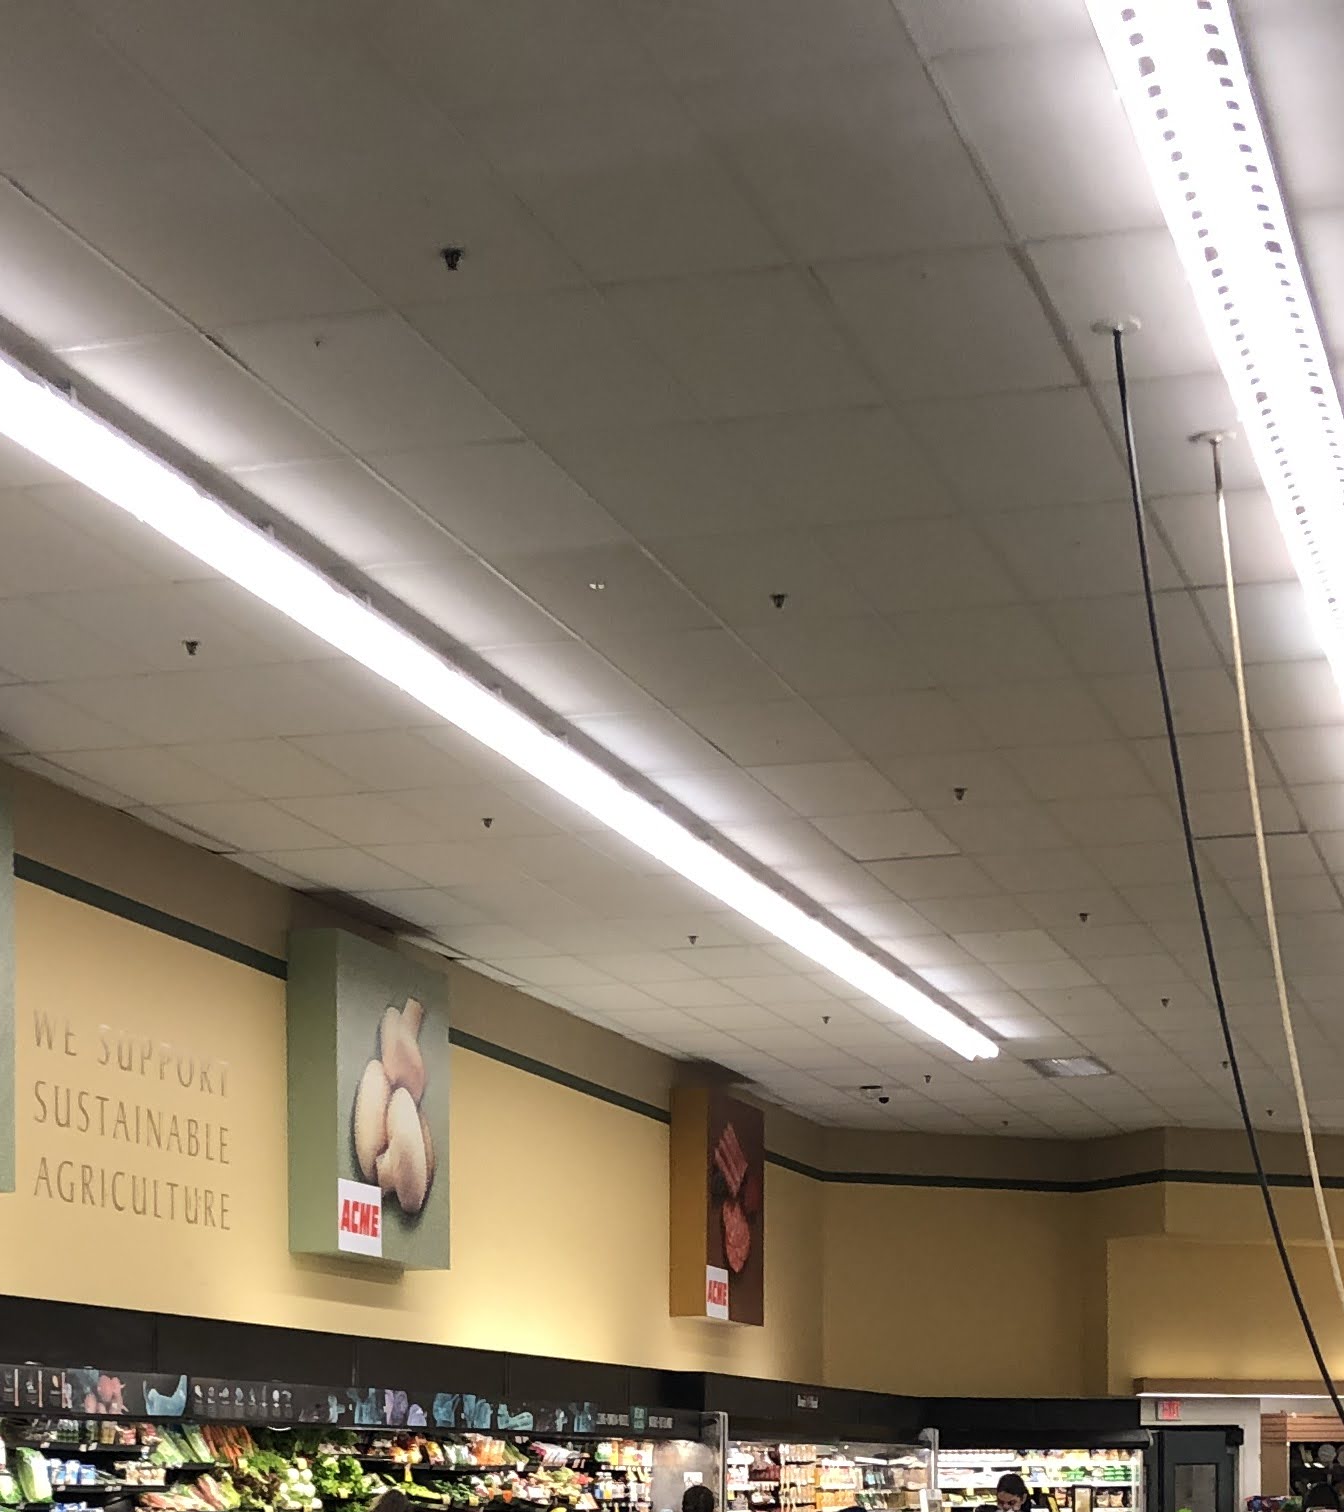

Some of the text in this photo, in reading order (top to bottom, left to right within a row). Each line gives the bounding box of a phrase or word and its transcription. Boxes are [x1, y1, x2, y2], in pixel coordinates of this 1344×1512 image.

[33, 1008, 230, 1097] WE SUPPORT
[34, 1080, 230, 1165] SUSTAINABLE
[34, 1157, 231, 1230] AGRICULTURE
[341, 1199, 379, 1237] ACME
[707, 1279, 727, 1307] ACME
